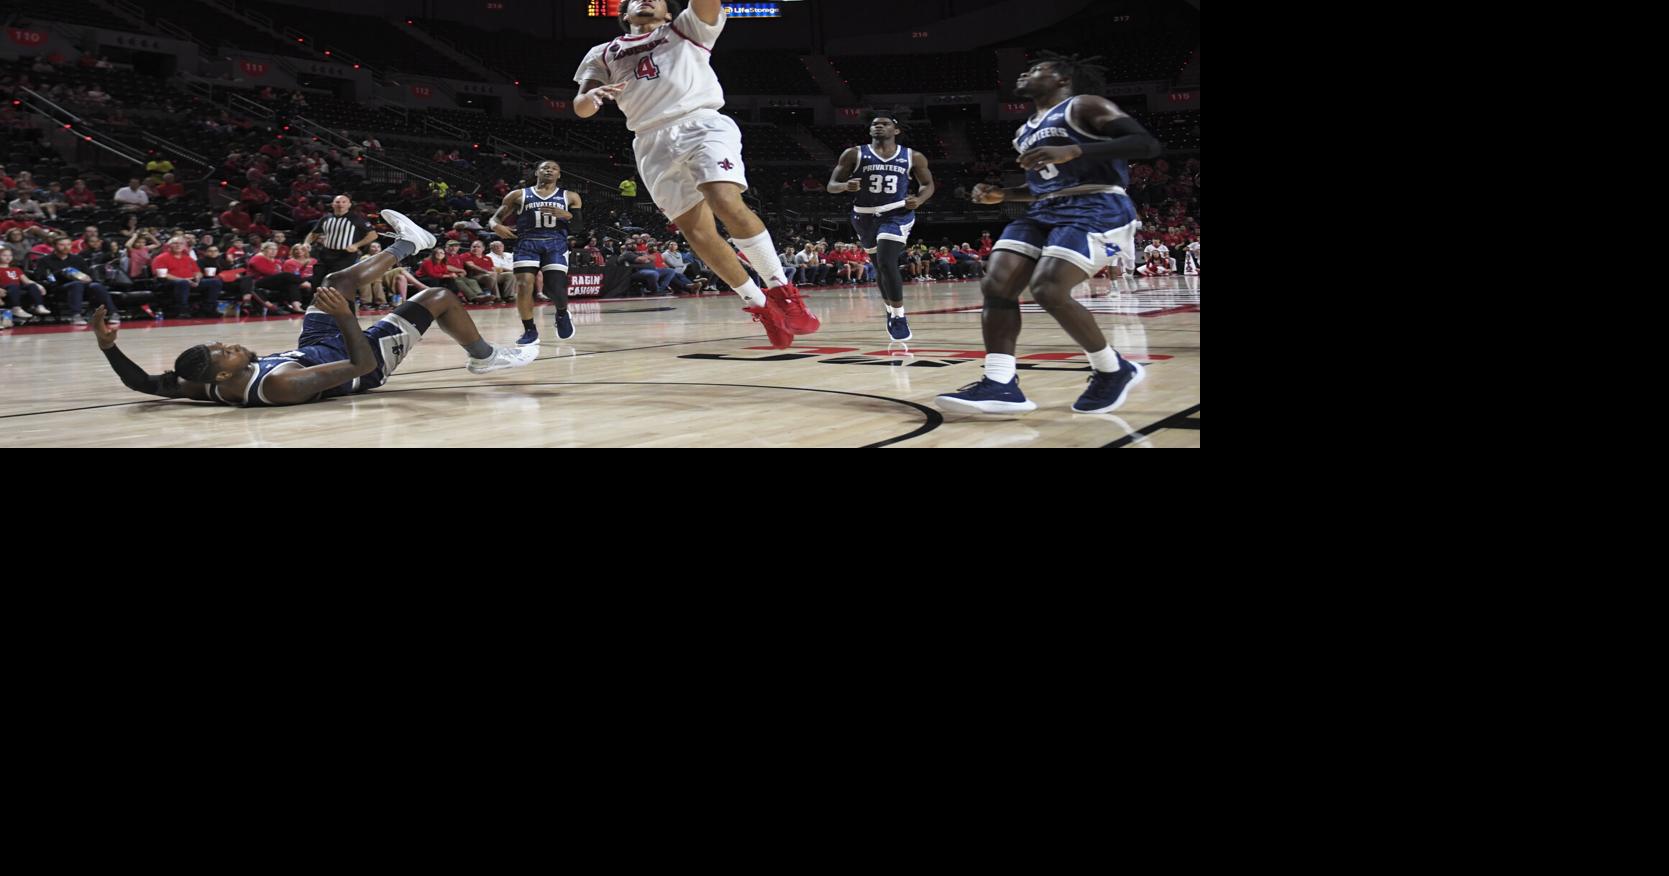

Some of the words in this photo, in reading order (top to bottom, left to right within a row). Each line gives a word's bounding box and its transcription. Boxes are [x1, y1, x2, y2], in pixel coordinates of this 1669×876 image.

[15, 31, 41, 42] 110
[246, 63, 264, 72] 111
[634, 52, 660, 80] 4
[868, 174, 898, 194] 33
[534, 210, 557, 228] 10
